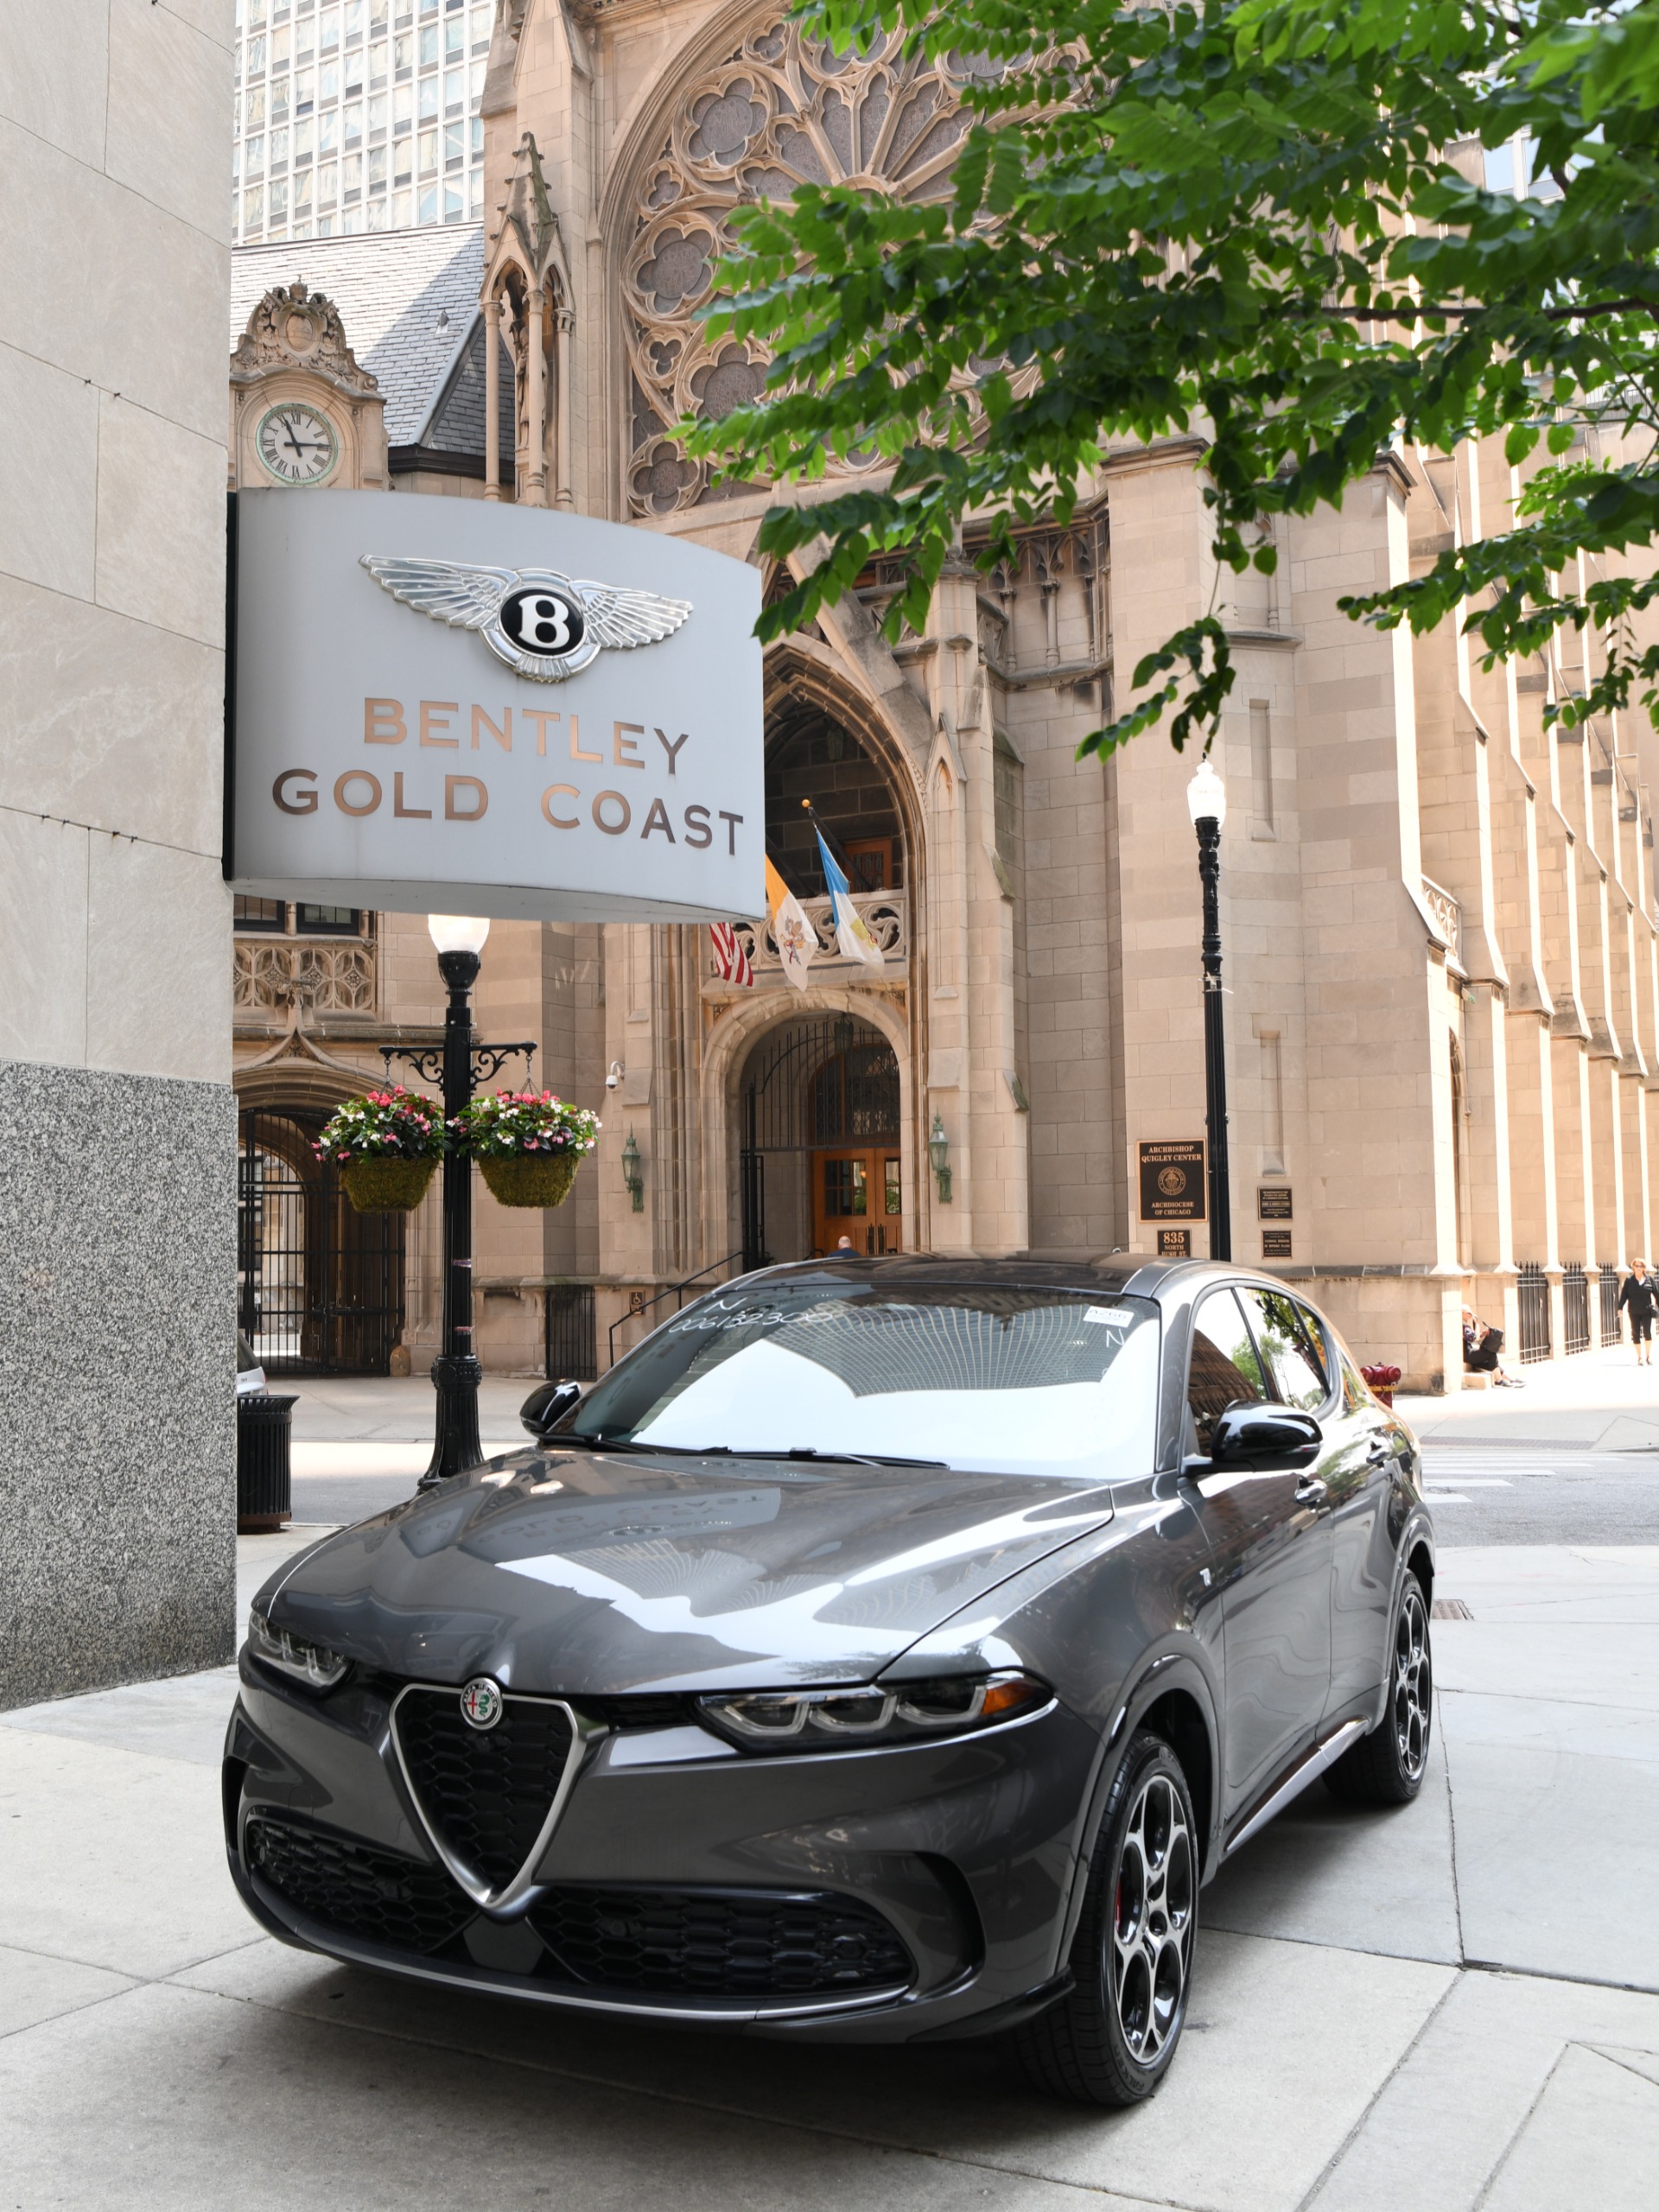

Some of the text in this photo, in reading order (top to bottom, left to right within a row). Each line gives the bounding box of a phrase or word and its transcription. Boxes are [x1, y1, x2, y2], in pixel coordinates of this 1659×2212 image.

[518, 594, 570, 649] B
[364, 697, 690, 775] BENTLEY
[272, 768, 744, 856] GOLD COAST
[1141, 1154, 1173, 1163] QUIGLEY
[1148, 1145, 1194, 1154] ARCHBISHOP
[1163, 1231, 1185, 1244] 835
[463, 1685, 476, 1703] ALFA
